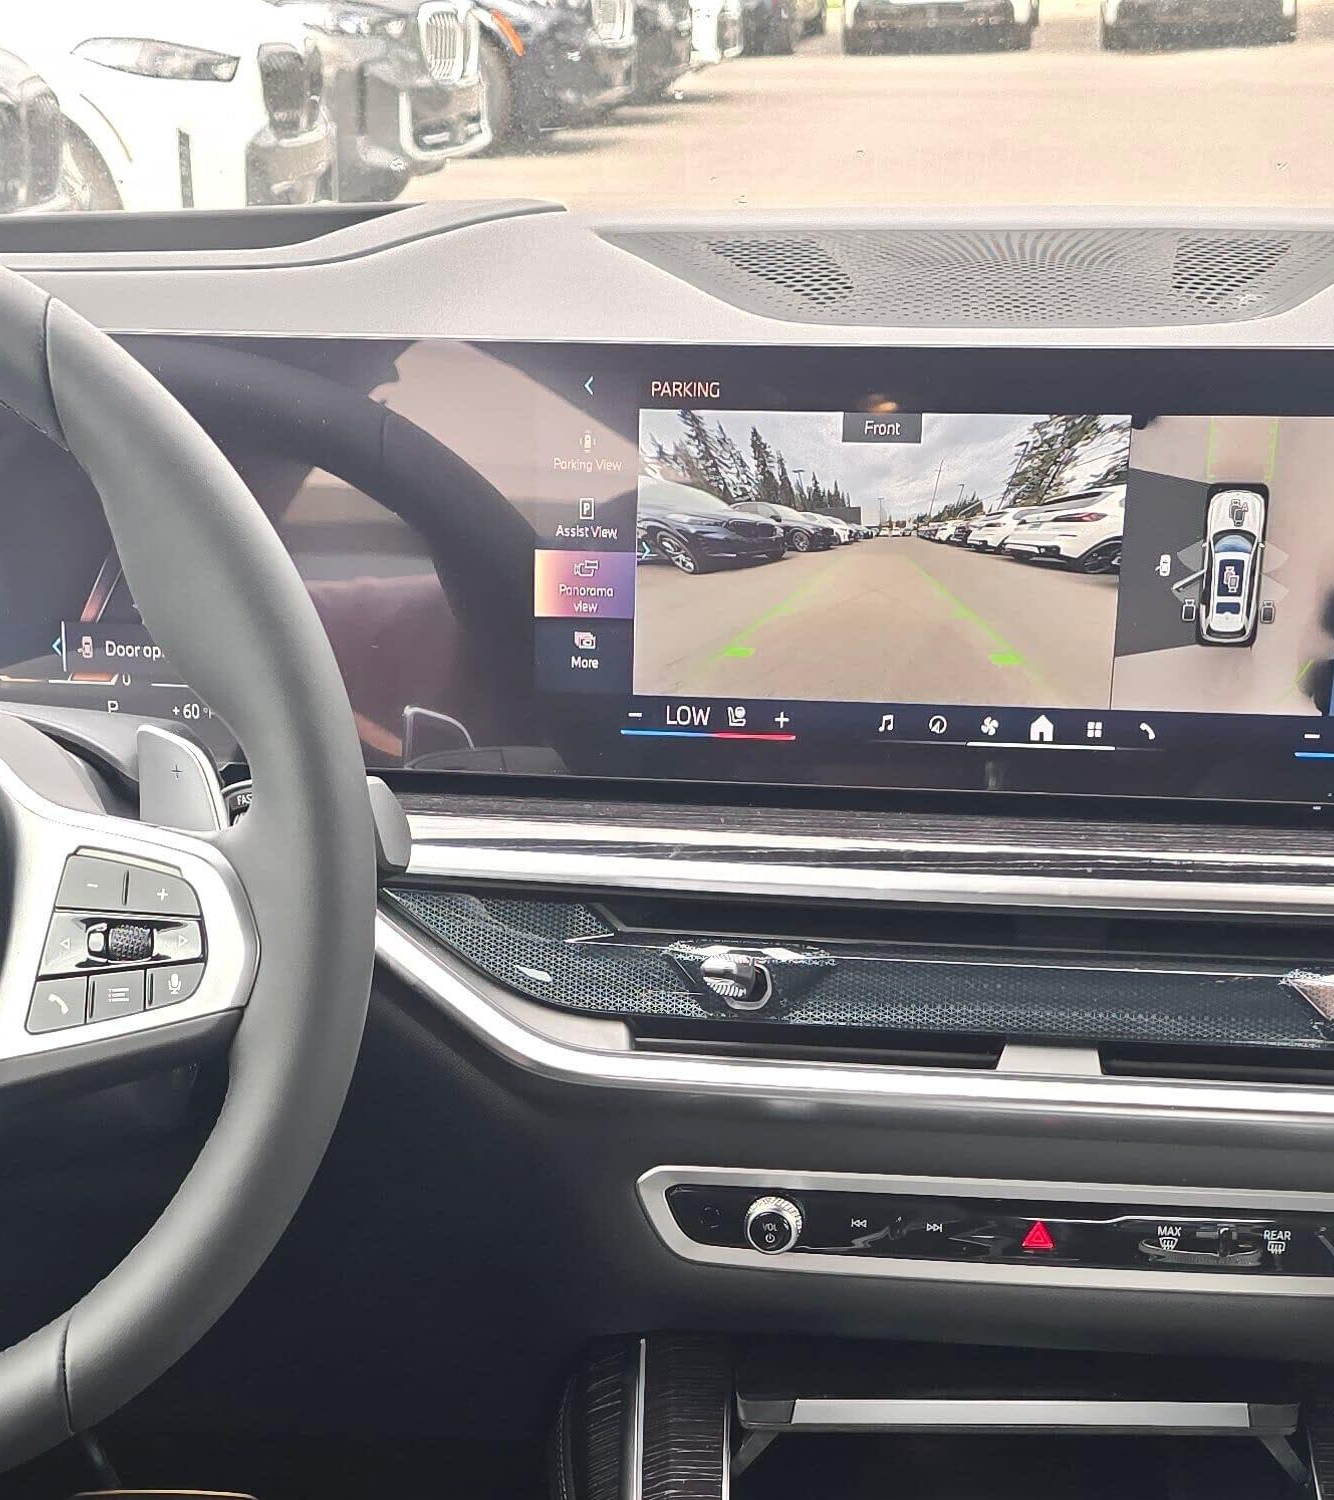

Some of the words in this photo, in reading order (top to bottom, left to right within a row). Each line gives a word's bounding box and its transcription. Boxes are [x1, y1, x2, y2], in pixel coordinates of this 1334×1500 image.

[651, 381, 720, 398] PARKING
[864, 420, 901, 435] Front
[553, 458, 592, 473] Parking
[595, 459, 622, 472] View
[556, 524, 589, 538] Assist
[590, 525, 618, 539] View
[559, 584, 614, 598] Panorama
[573, 600, 598, 613] view
[105, 641, 140, 658] Door
[142, 646, 166, 661] op
[571, 656, 599, 669] More
[107, 700, 119, 713] P
[666, 705, 711, 726] LOW
[236, 794, 253, 806] FAS
[762, 1223, 778, 1231] VOL
[1157, 1225, 1182, 1237] MAX
[1263, 1230, 1292, 1241] REAR
